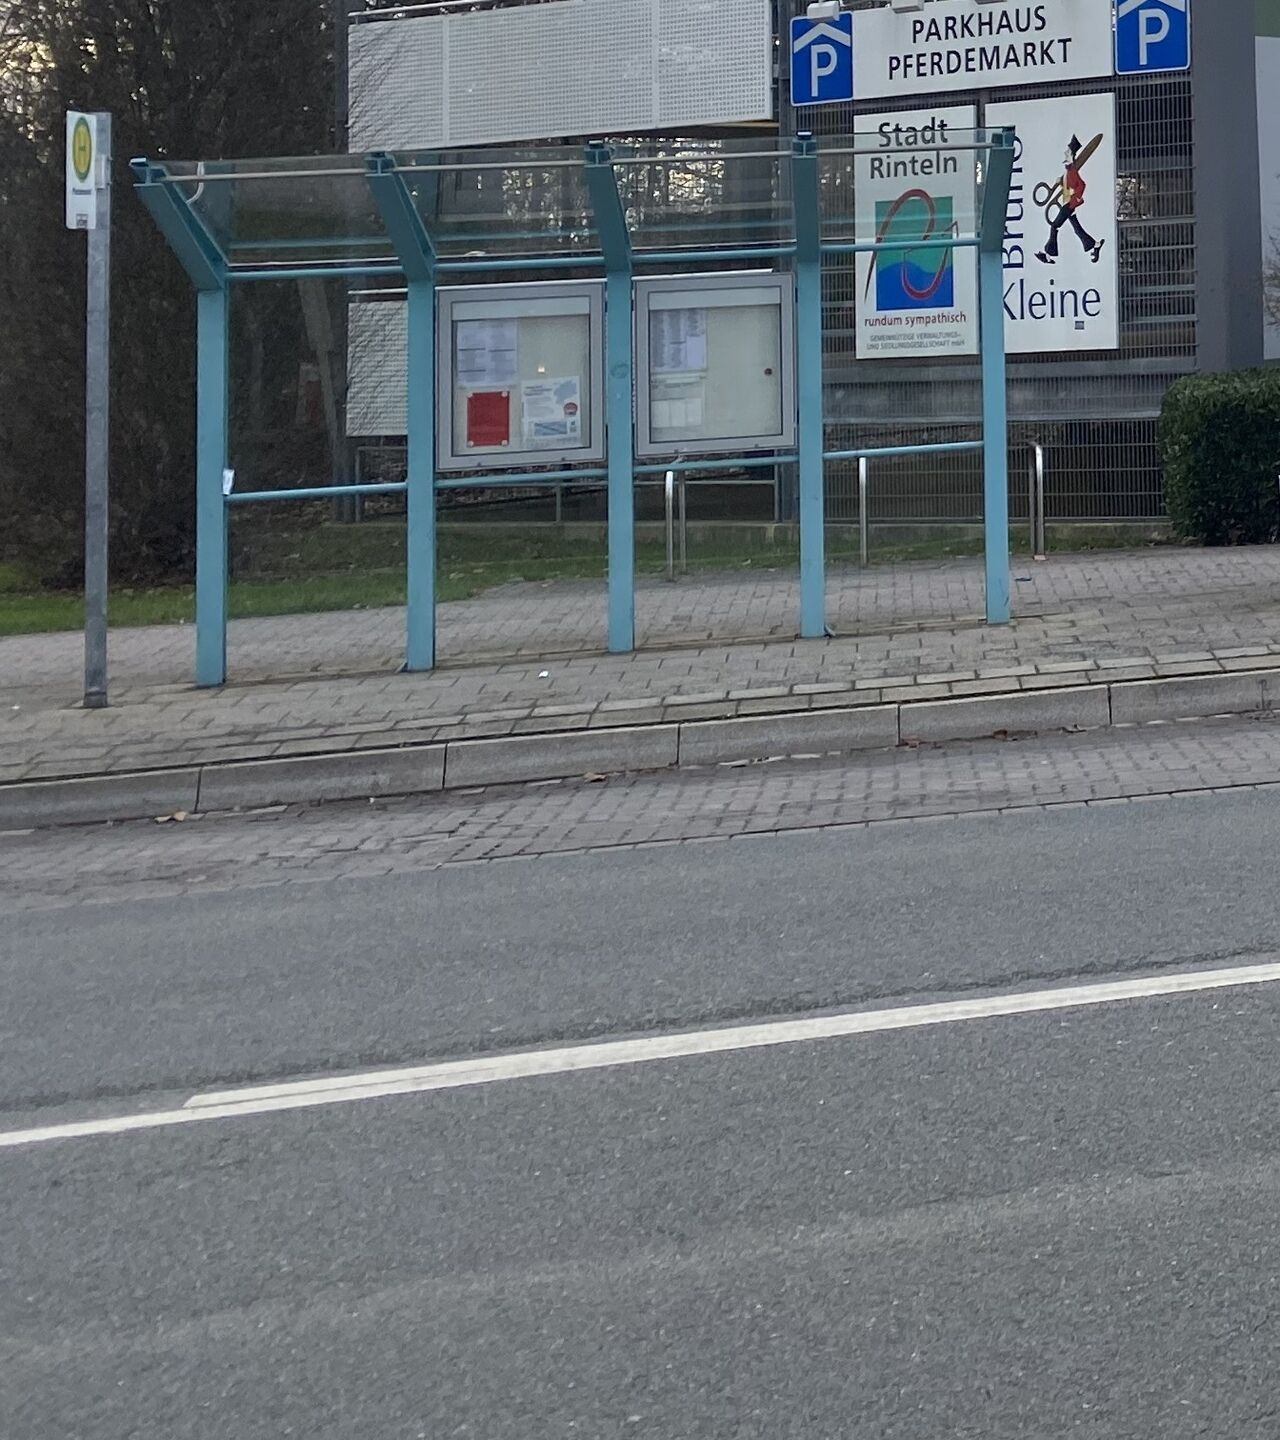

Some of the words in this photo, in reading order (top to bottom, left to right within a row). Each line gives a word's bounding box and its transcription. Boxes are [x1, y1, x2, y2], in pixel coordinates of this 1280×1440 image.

[912, 5, 1046, 44] PARKHAUS
[1138, 8, 1171, 66] P
[810, 43, 838, 98] P
[888, 38, 1072, 81] PFERDEMARKT
[878, 116, 948, 148] Stadt
[870, 150, 957, 179] Rinteln
[864, 315, 903, 327] rundum
[905, 311, 967, 328] sympathisch
[1003, 278, 1102, 321] Kleine
